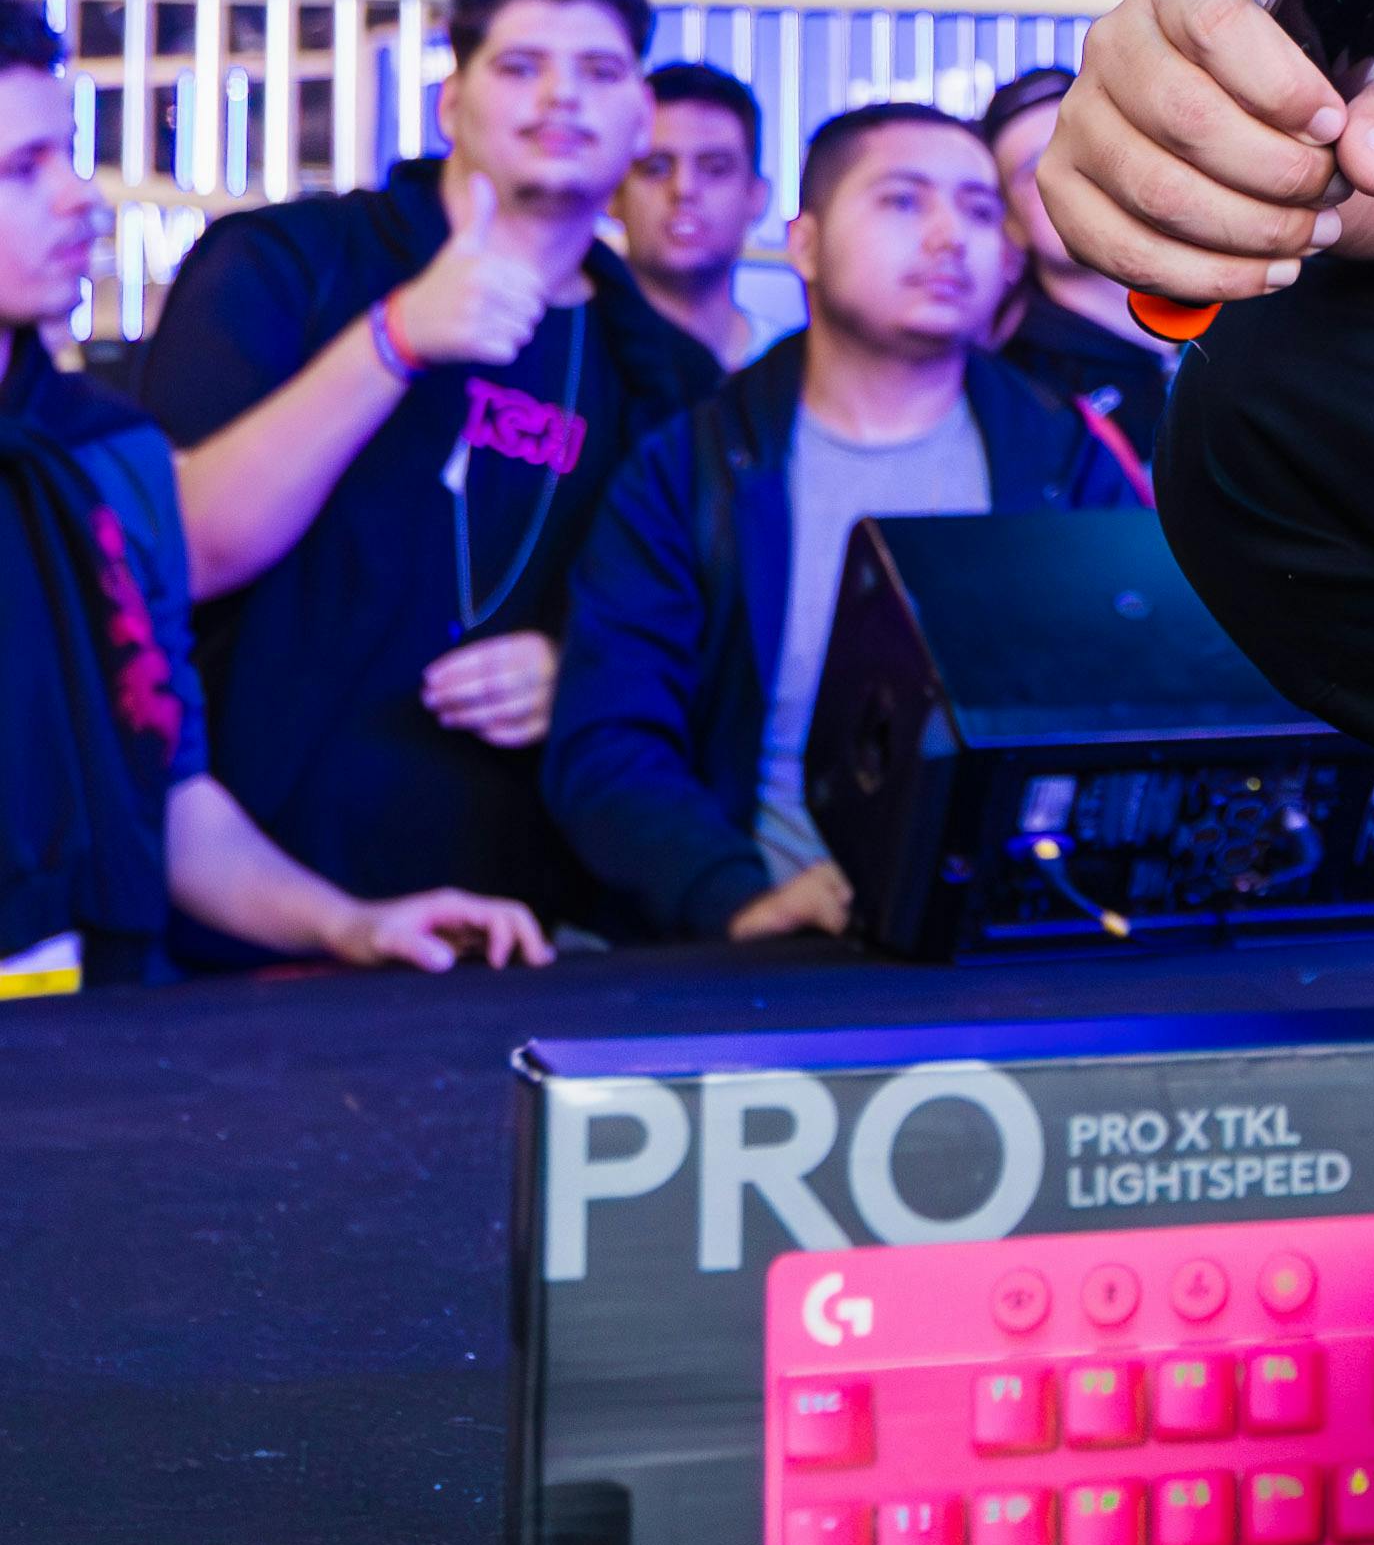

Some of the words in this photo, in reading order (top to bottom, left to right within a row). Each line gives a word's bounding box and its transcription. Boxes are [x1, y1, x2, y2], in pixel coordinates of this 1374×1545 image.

[1069, 1110, 1169, 1158] PRO
[1174, 1108, 1211, 1152] X
[1215, 1104, 1301, 1150] TKL
[544, 1061, 1046, 1282] PRO
[1067, 1149, 1352, 1209] LIGHTSPEED
